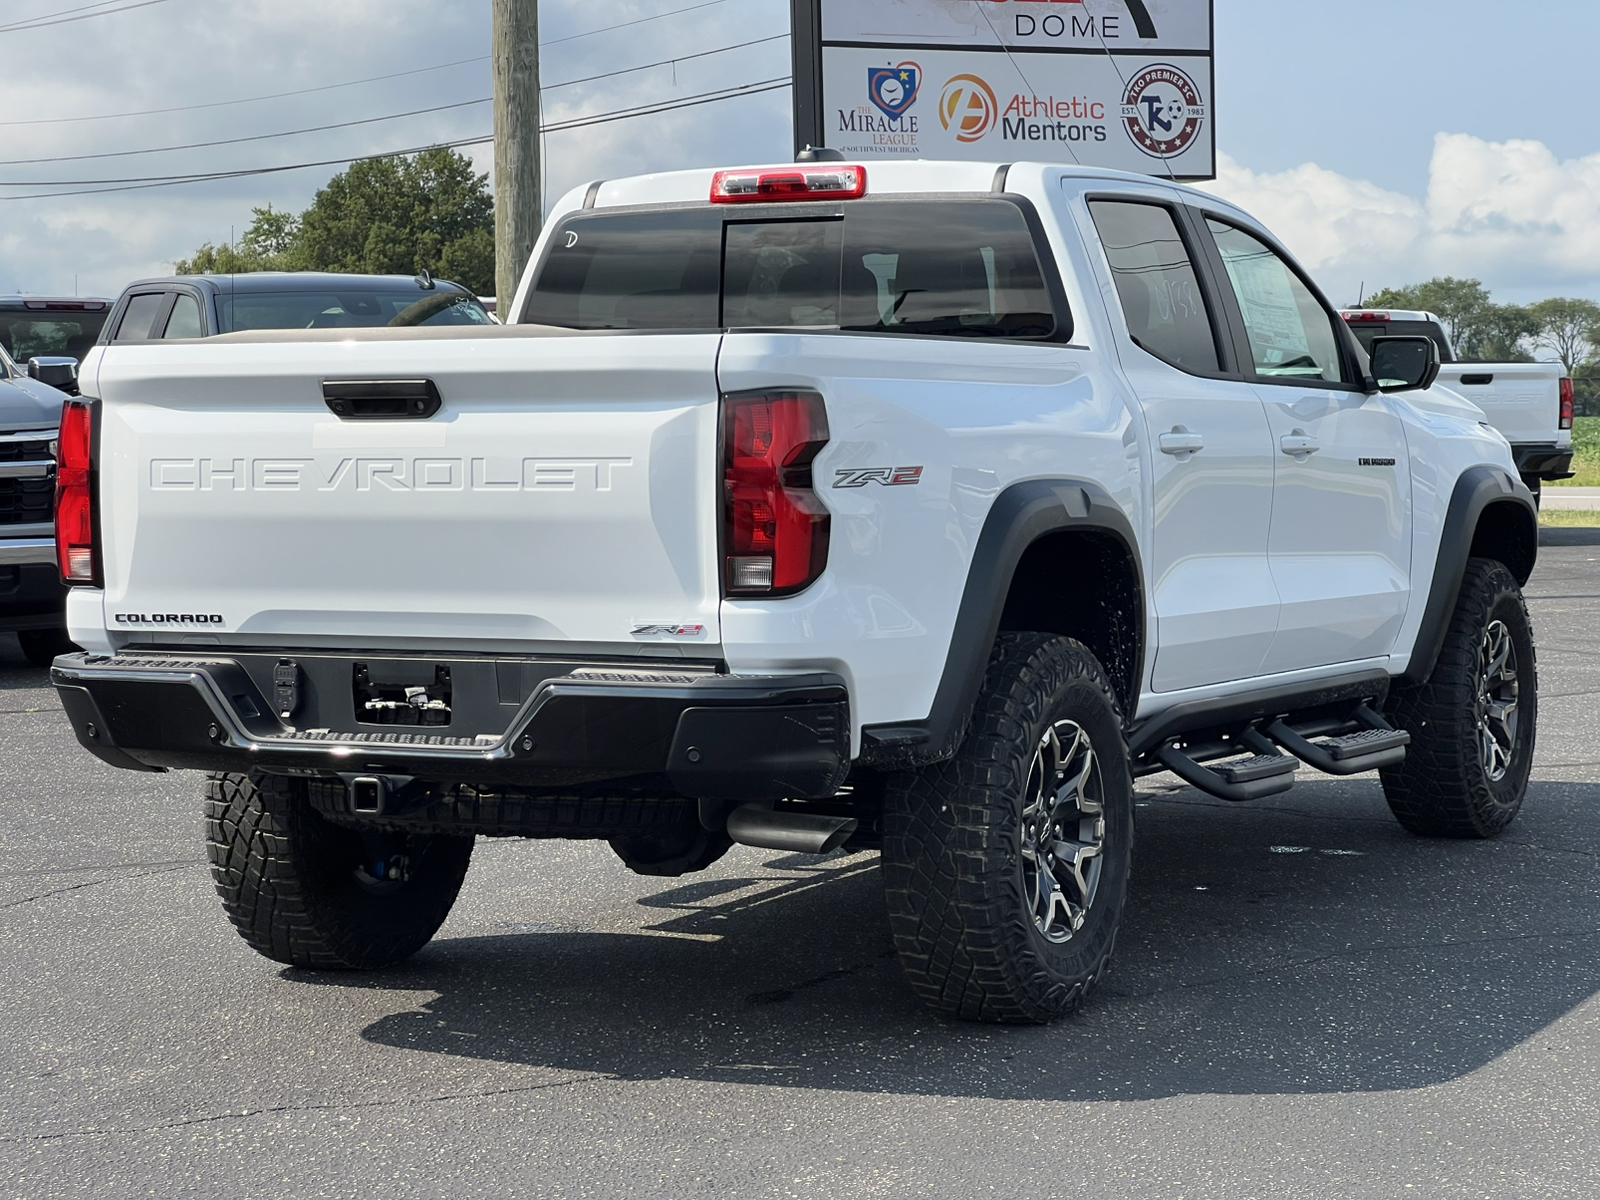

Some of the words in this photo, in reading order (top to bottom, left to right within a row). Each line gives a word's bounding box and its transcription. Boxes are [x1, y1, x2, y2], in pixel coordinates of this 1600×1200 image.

[1015, 14, 1120, 38] DOME
[1130, 79, 1145, 98] TKO
[1145, 71, 1184, 88] PREMIER
[1182, 85, 1194, 99] SC
[857, 106, 872, 114] THE
[1002, 94, 1105, 120] Athletic
[1121, 107, 1136, 115] EST.
[1187, 108, 1204, 116] 1983
[838, 109, 919, 133] MIRACLE
[1002, 117, 1107, 142] Mentors
[873, 134, 917, 146] LEAGUE
[565, 230, 578, 248] D
[149, 456, 634, 491] CHEVROLET
[832, 465, 924, 488] ZR2
[115, 613, 223, 623] COLORADO
